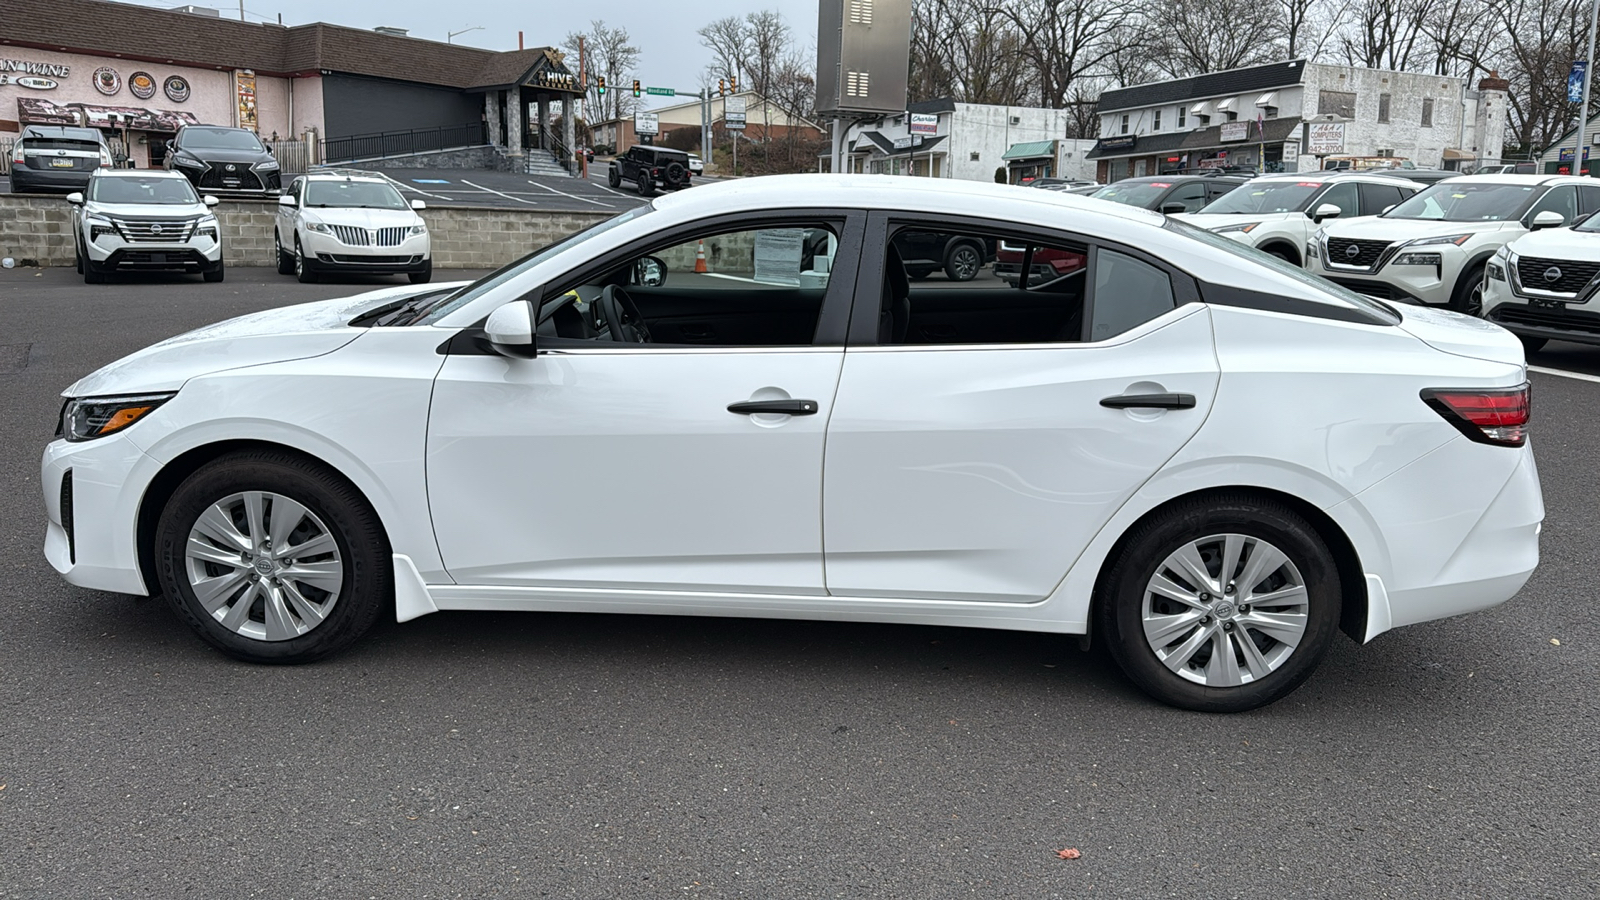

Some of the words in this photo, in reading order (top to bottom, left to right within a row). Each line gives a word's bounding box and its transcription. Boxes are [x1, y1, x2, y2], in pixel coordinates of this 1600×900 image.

[24, 61, 70, 78] WINE
[547, 71, 573, 85] HIVE
[540, 81, 573, 90] LOUNGE
[1310, 131, 1343, 139] COMPUTERS
[1308, 145, 1343, 153] 942-9700
